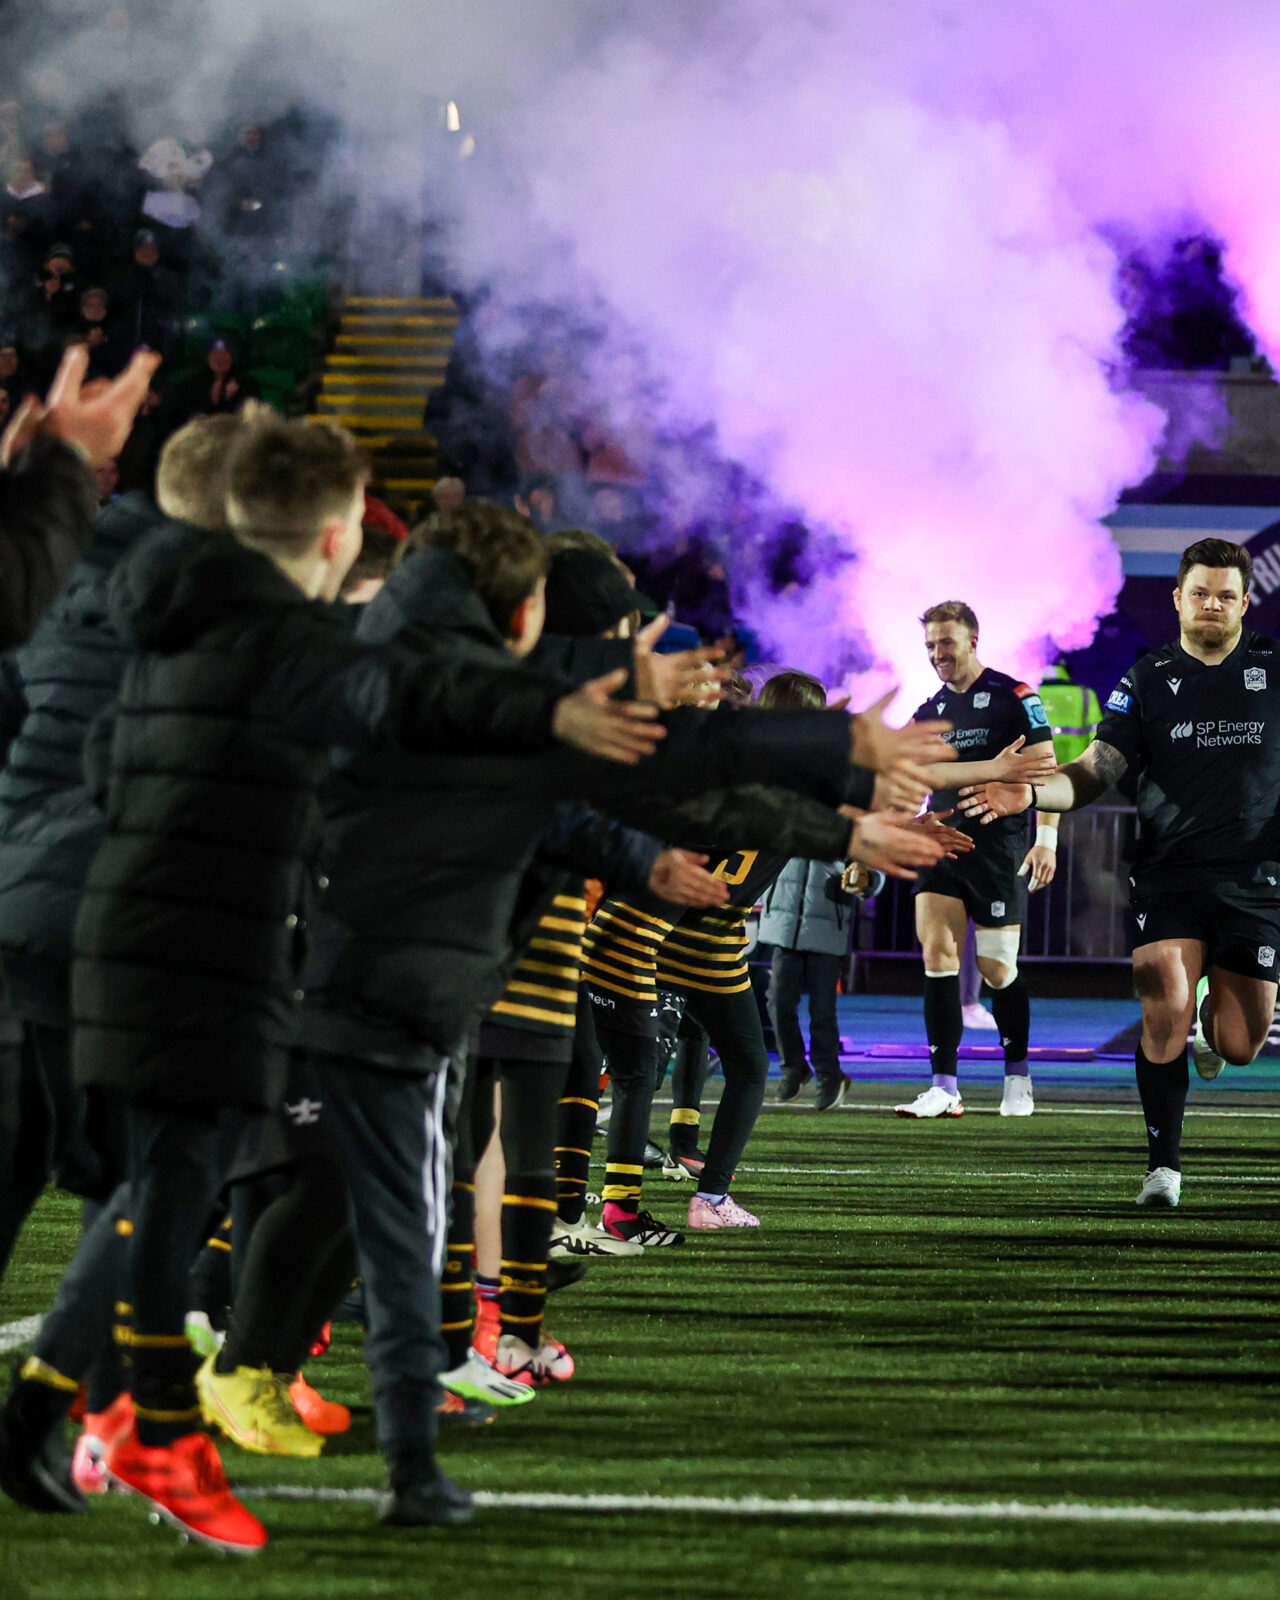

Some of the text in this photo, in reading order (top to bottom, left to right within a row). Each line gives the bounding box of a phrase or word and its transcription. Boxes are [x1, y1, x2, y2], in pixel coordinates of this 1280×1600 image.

[943, 728, 990, 741] SP Energy
[1196, 720, 1265, 735] SP Energy
[1196, 732, 1262, 748] Networks
